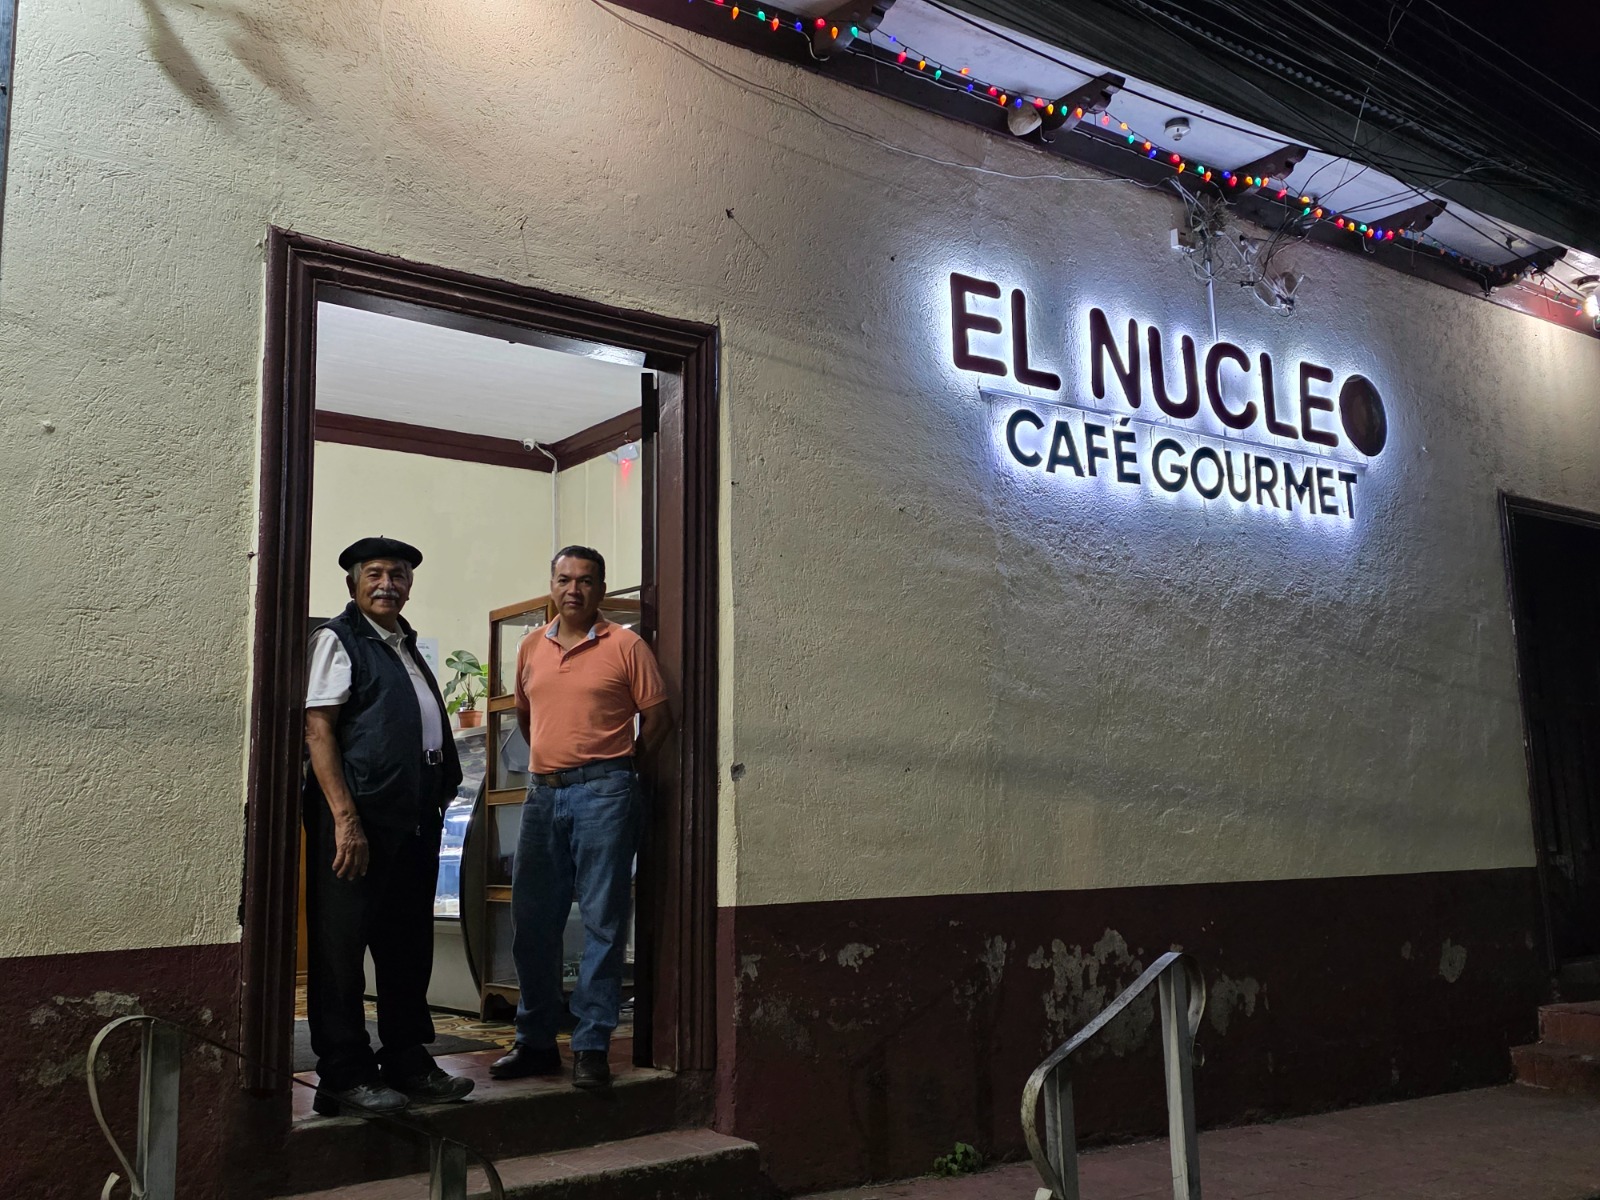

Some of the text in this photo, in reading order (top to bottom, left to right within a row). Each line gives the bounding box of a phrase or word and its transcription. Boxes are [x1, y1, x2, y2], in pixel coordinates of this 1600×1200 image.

[950, 272, 1388, 457] EL NUCLEO
[1006, 409, 1358, 519] CAFÉ GOURMET
